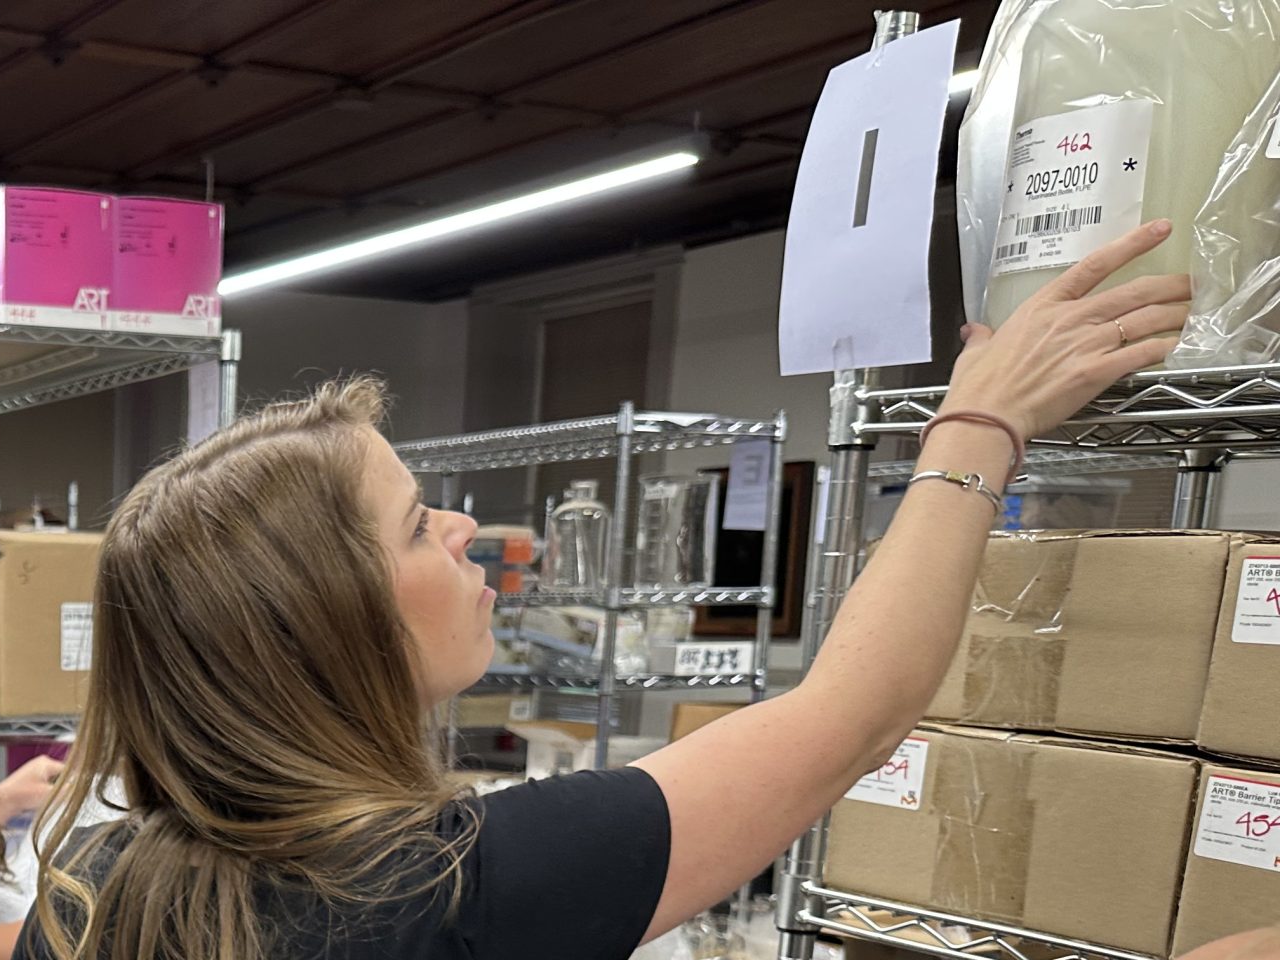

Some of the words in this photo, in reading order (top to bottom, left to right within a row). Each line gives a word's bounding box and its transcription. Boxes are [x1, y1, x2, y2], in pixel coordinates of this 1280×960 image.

[1056, 132, 1092, 157] 462
[1025, 162, 1098, 196] 2097-0010
[72, 287, 110, 313] ART
[181, 294, 218, 319] ART
[1238, 791, 1265, 801] Barrier
